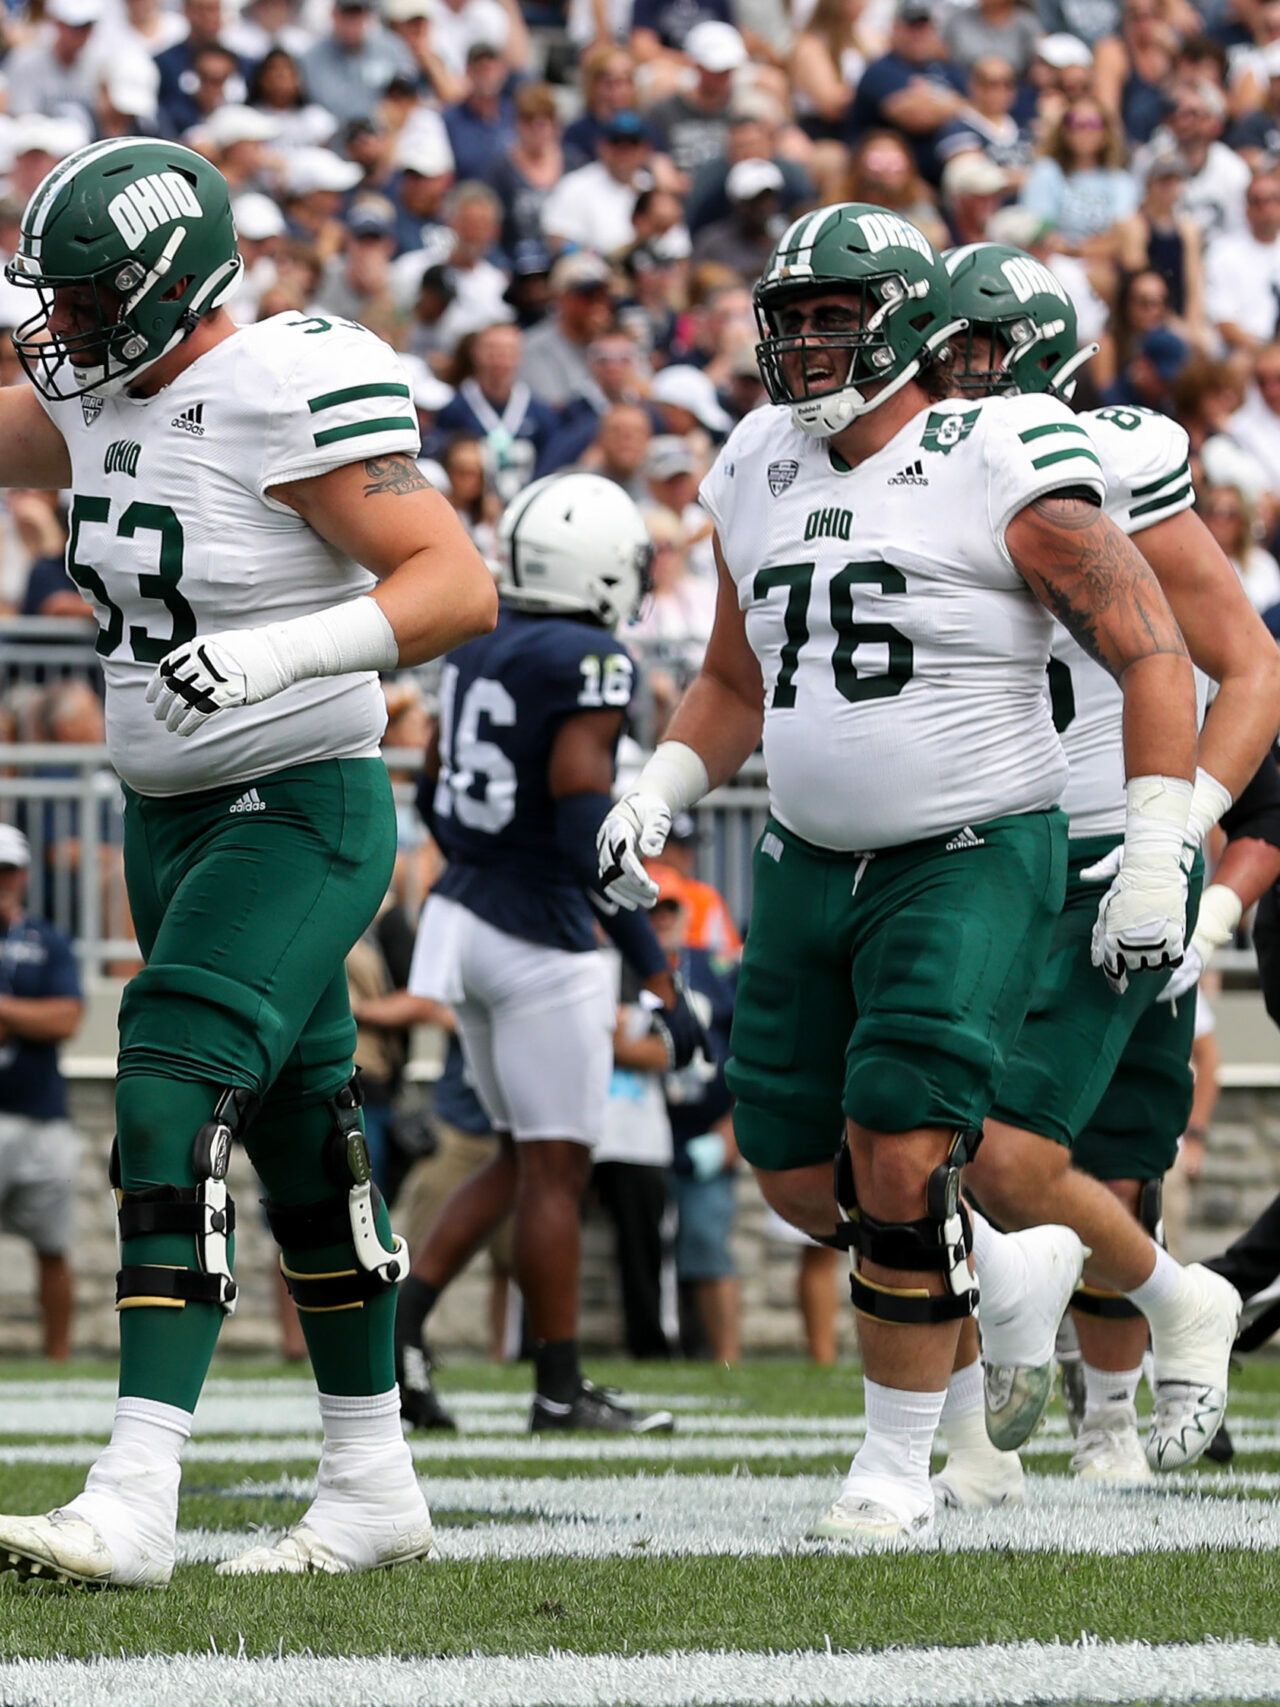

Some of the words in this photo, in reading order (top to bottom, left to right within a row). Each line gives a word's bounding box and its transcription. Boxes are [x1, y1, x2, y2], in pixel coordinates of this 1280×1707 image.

[108, 172, 203, 250] OHIO
[856, 213, 934, 266] OHIO
[171, 417, 206, 436] adidas
[104, 440, 142, 479] OHIO
[804, 507, 854, 542] OHIO
[68, 494, 197, 664] 53
[753, 560, 914, 709] 76
[577, 654, 634, 707] 16
[433, 662, 518, 835] 16
[229, 801, 266, 813] adidas
